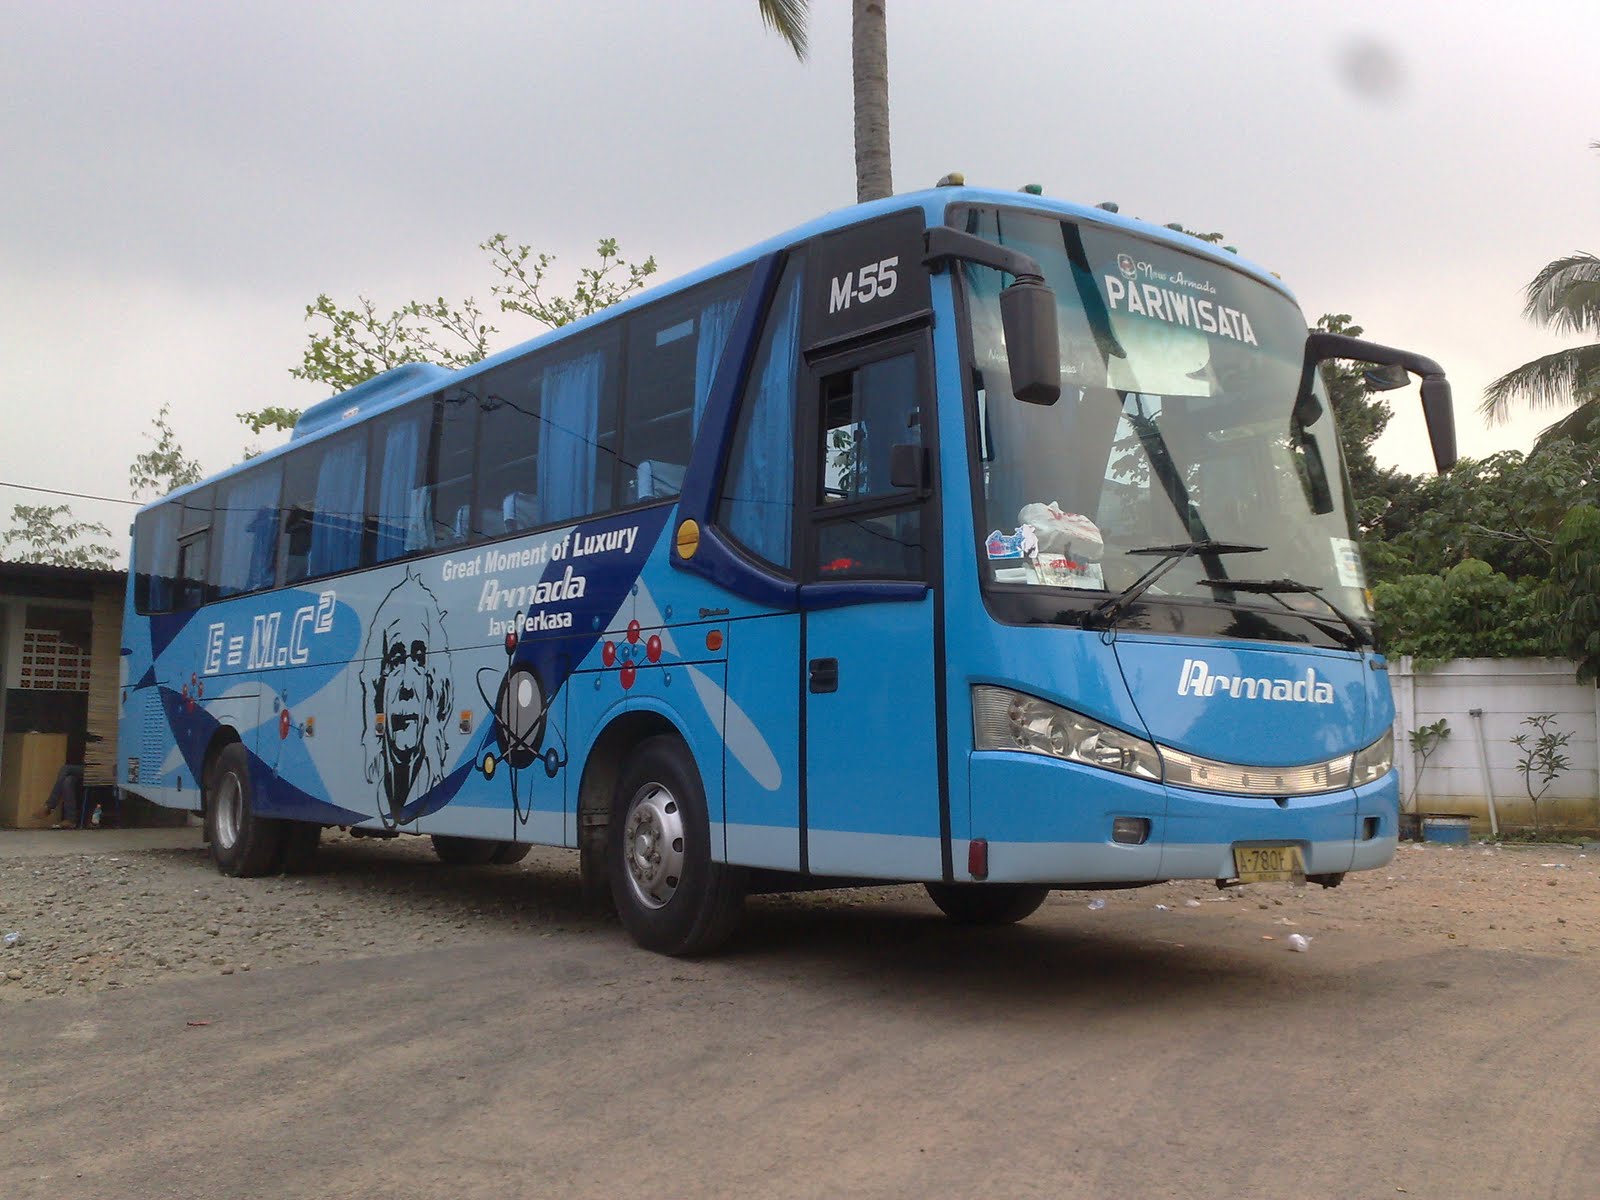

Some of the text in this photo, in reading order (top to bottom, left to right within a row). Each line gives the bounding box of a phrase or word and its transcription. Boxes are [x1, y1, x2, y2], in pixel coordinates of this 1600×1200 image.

[829, 256, 899, 314] M-55
[1137, 261, 1217, 294] New Armada
[1104, 274, 1258, 346] PARIWISATA
[442, 526, 639, 581] Great Moment of Luxury
[477, 565, 586, 612] Armada
[516, 610, 573, 632] Perkasa
[1177, 658, 1334, 704] Armada
